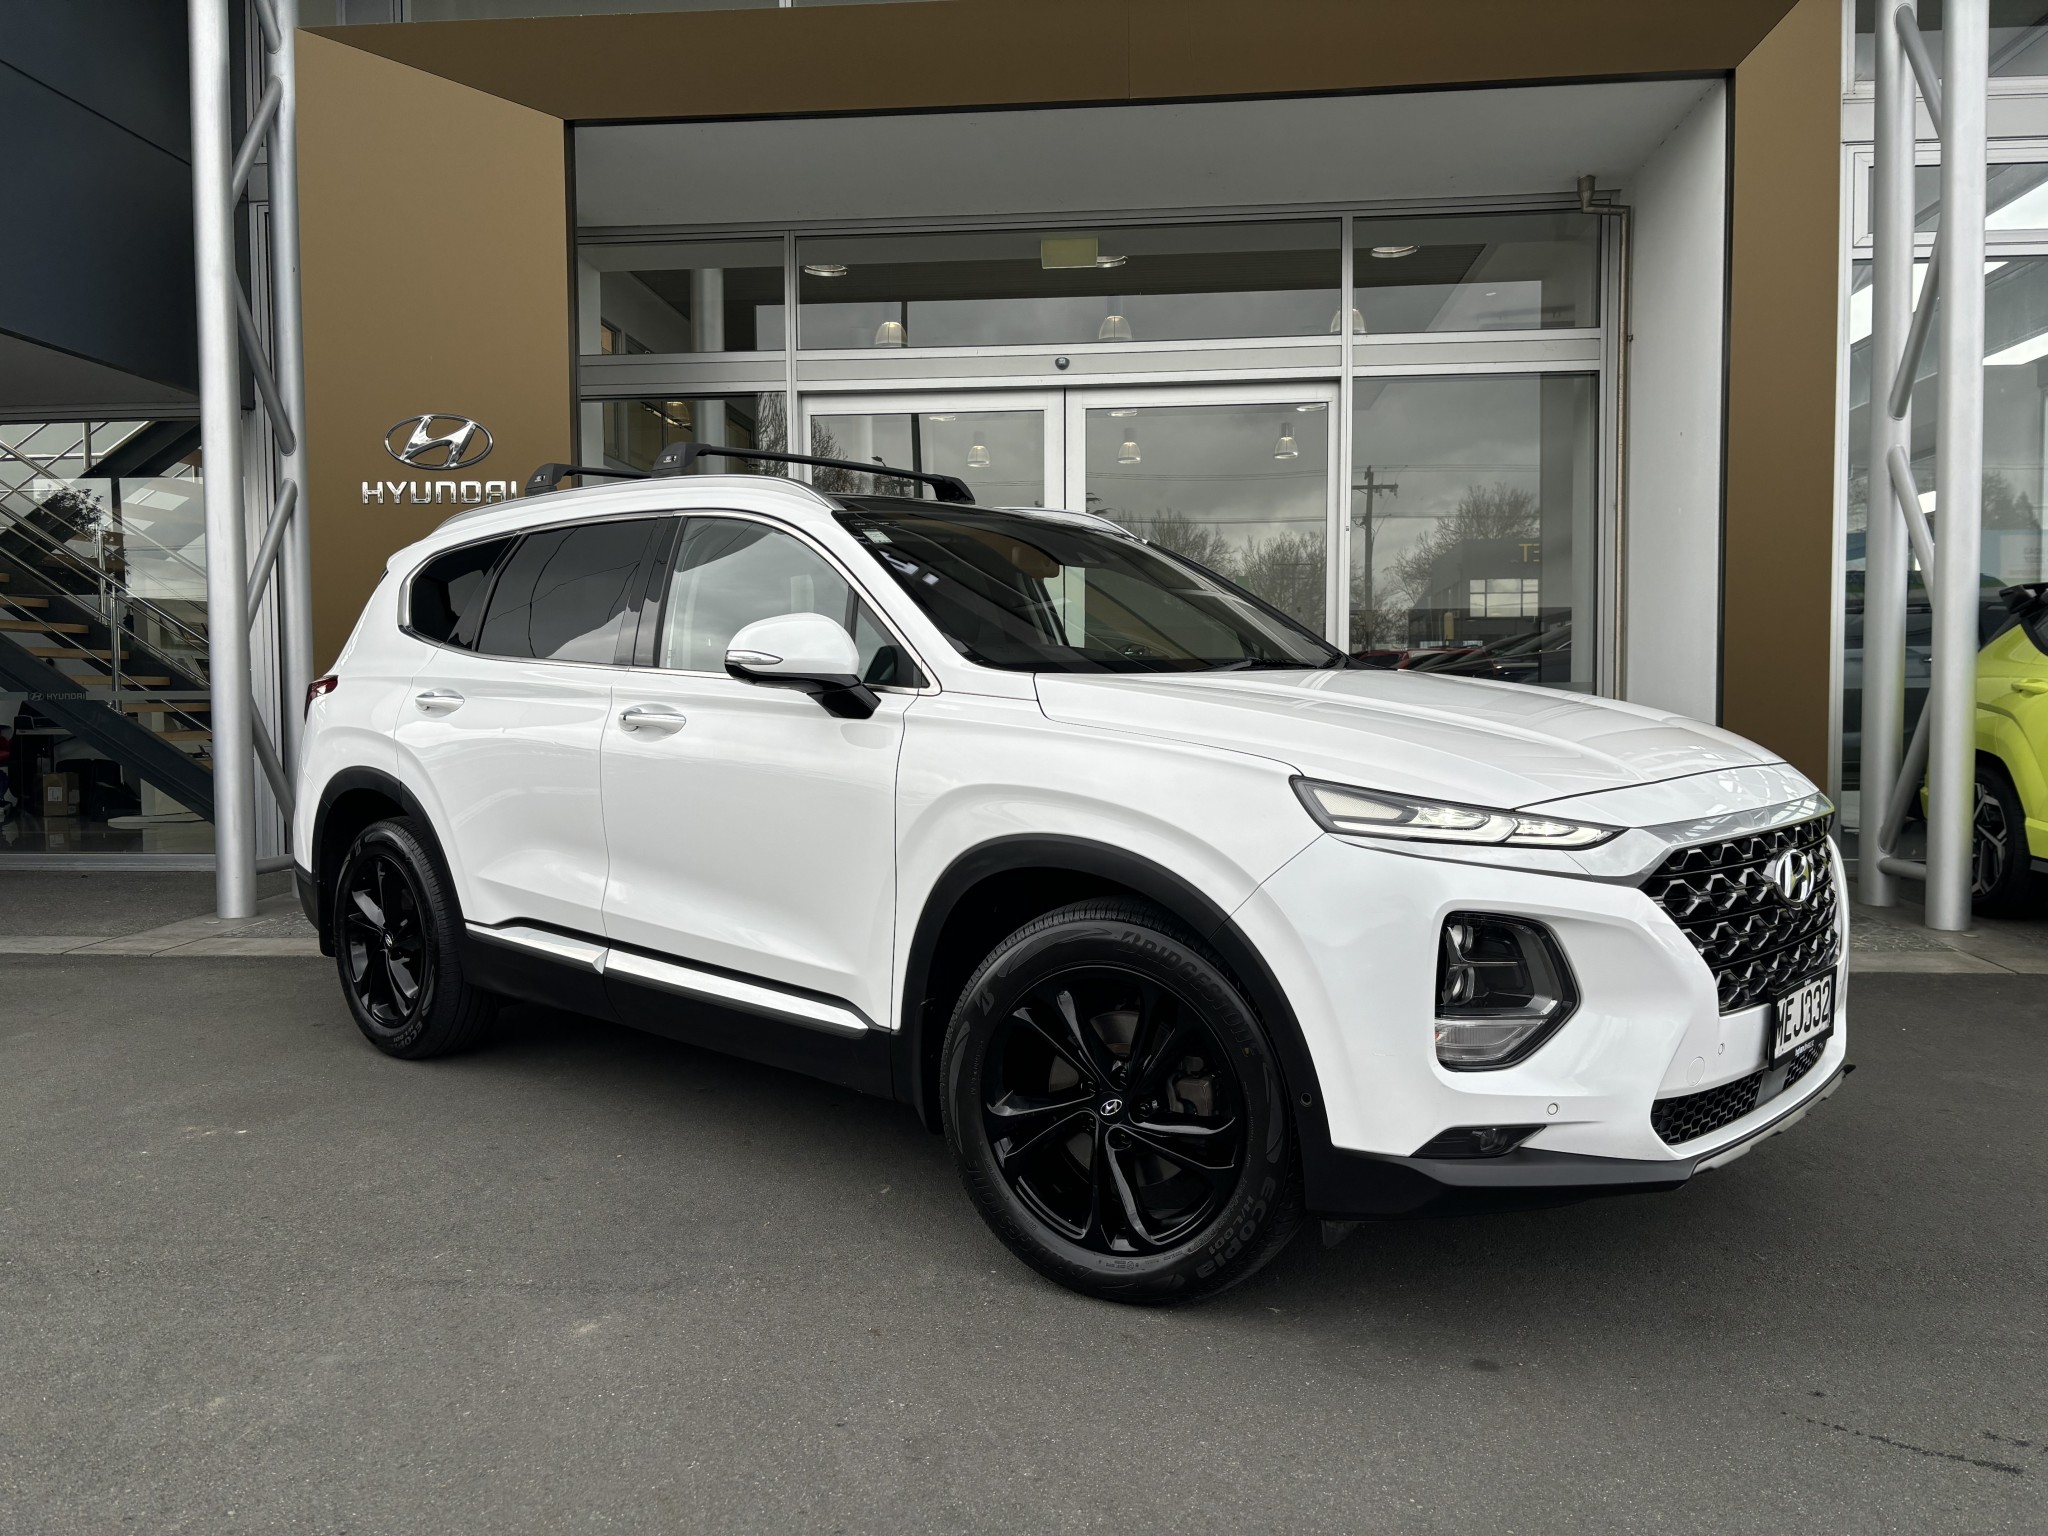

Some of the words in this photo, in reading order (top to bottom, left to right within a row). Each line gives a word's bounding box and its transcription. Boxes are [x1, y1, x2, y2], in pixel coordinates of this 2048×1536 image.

[362, 480, 518, 504] HYUNDAI
[46, 692, 86, 700] HYUNDAI
[1775, 980, 1831, 1047] MEJ332
